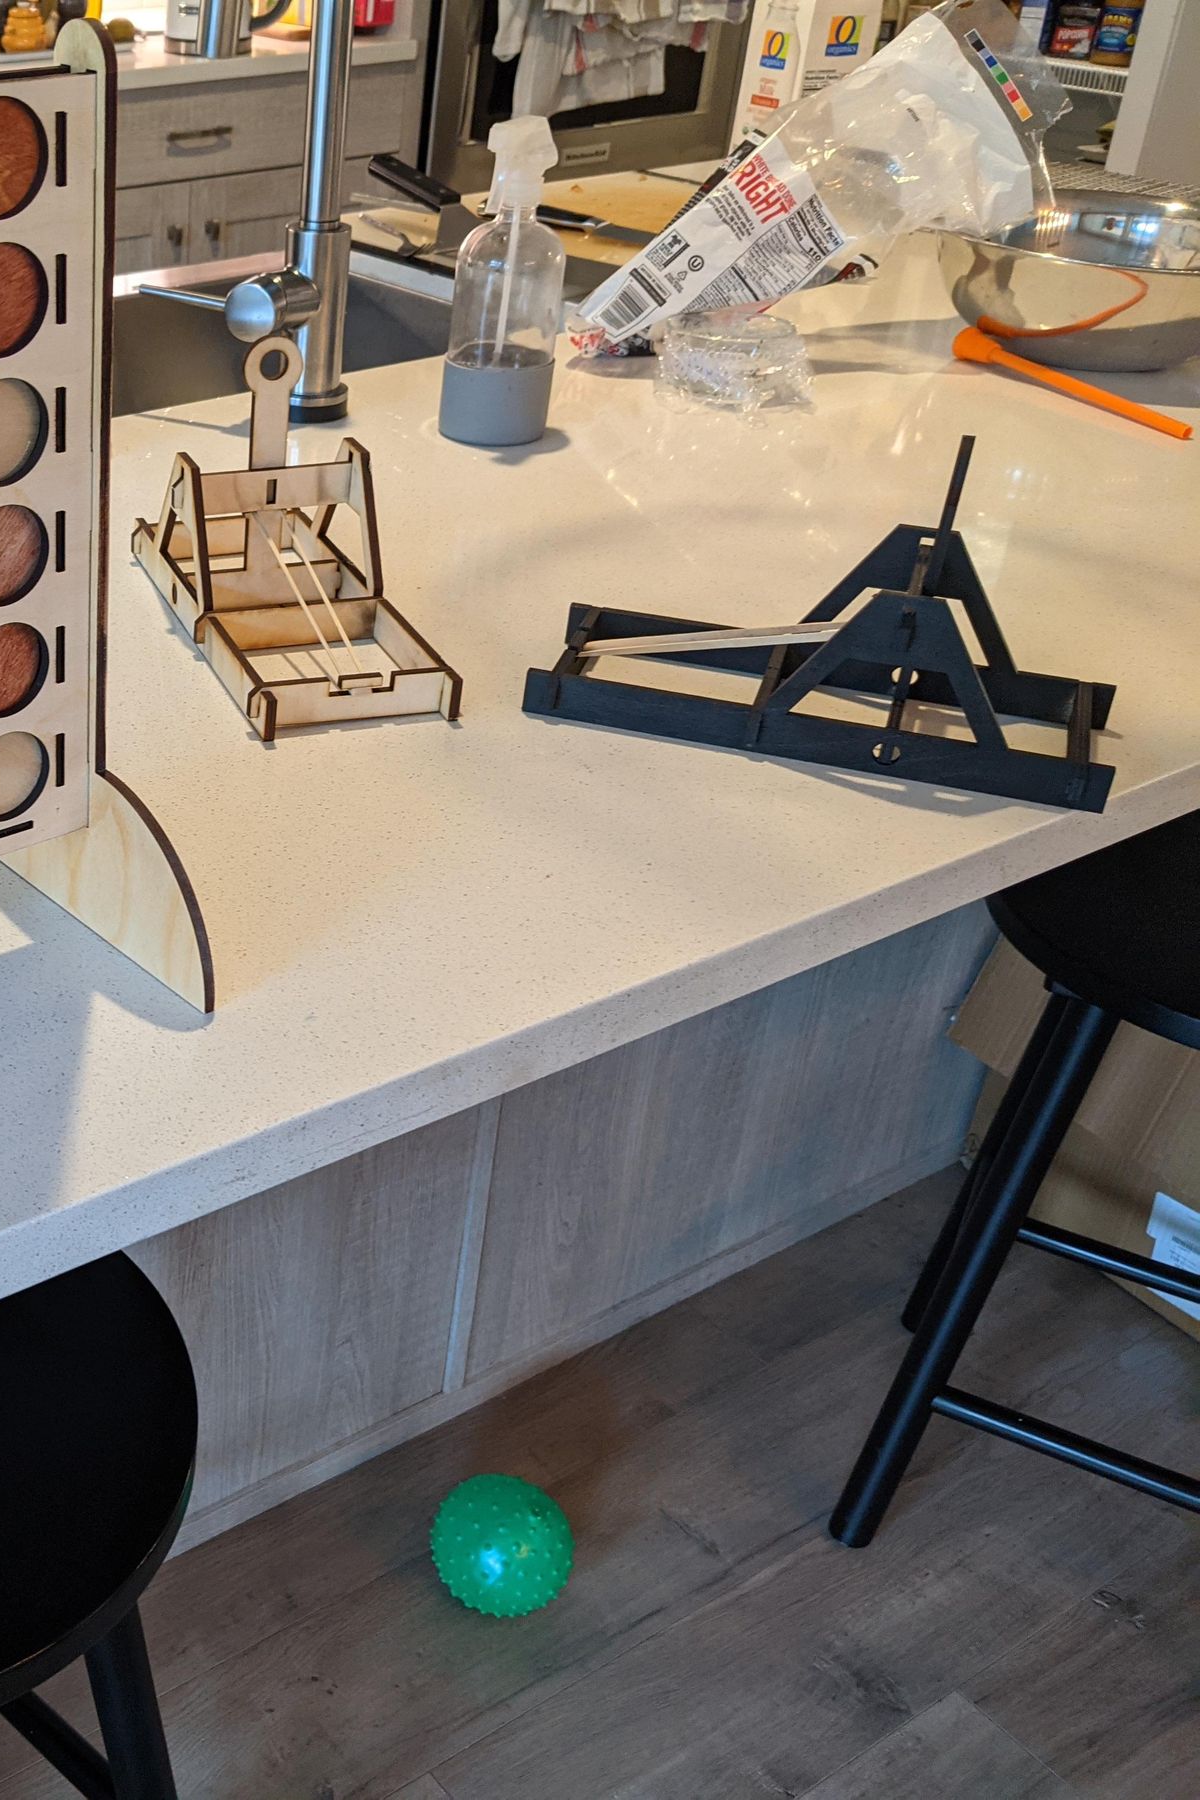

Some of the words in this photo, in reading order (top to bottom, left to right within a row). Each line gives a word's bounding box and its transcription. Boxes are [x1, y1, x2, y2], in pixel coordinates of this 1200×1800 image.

[728, 161, 789, 224] RIGHT
[752, 153, 770, 177] WHITE
[784, 190, 798, 212] DONE
[787, 216, 804, 241] Calories
[806, 246, 821, 262] 110
[807, 198, 827, 228] Nutrition
[824, 225, 840, 247] Facts
